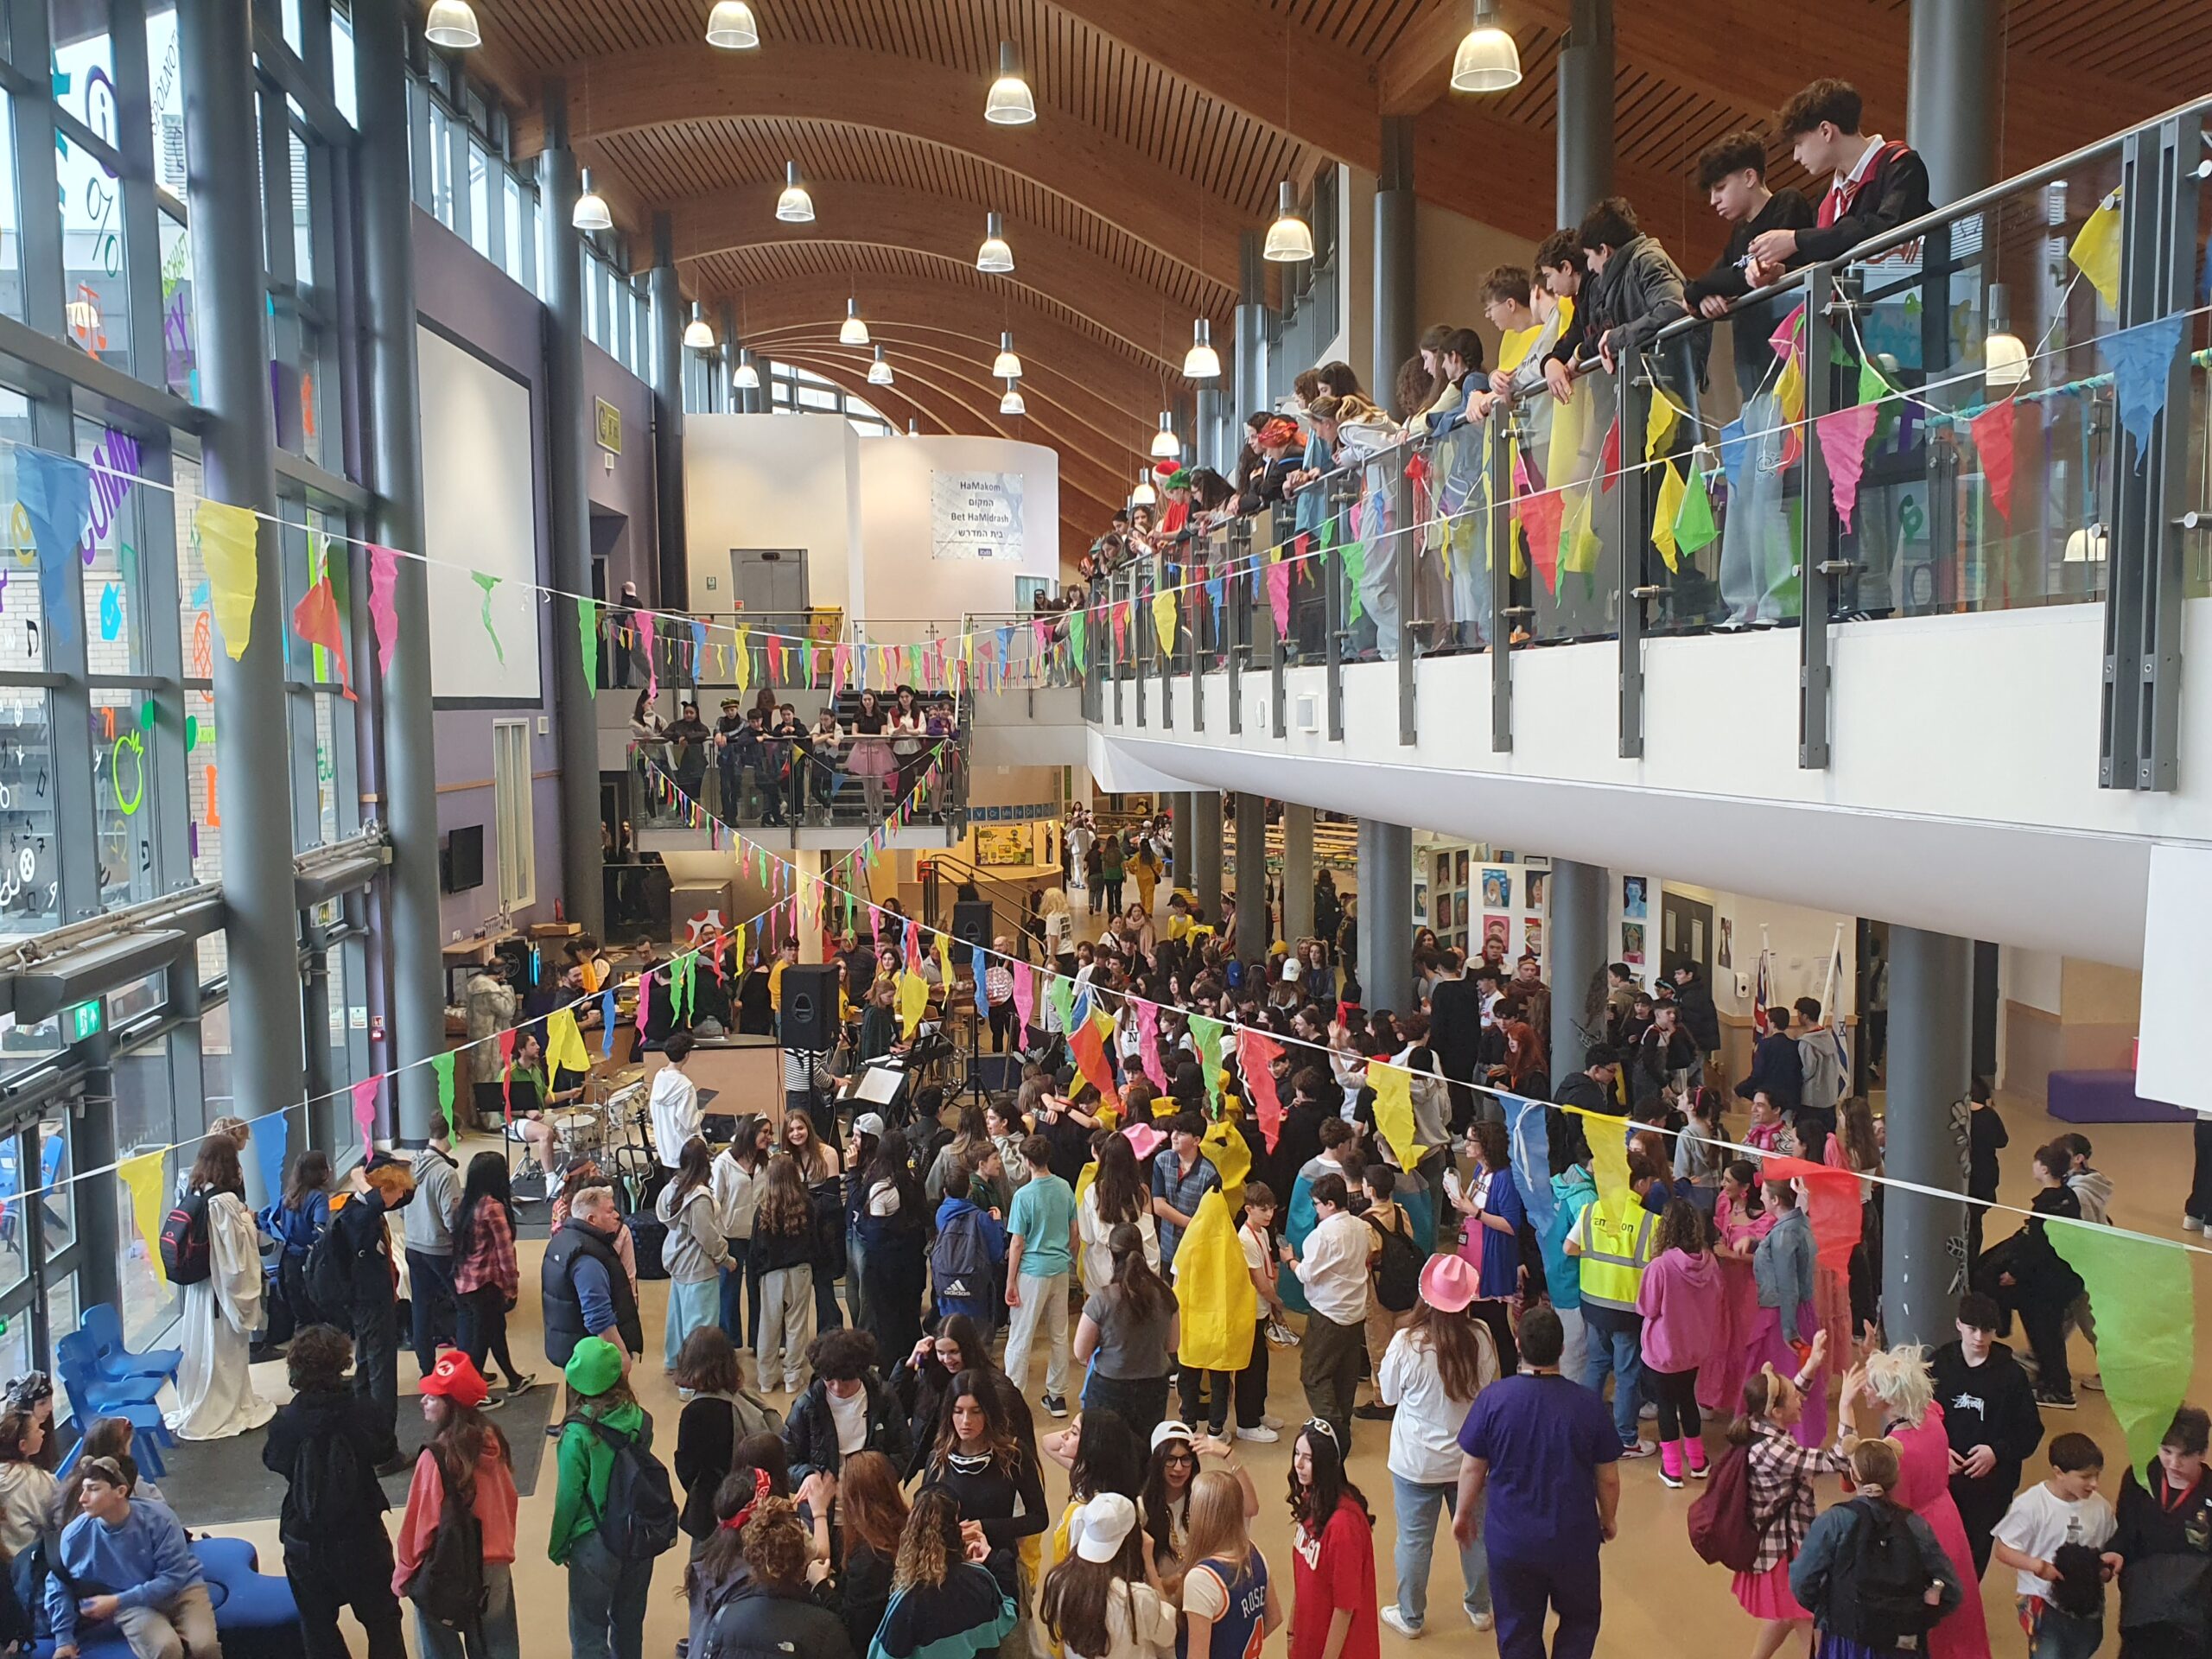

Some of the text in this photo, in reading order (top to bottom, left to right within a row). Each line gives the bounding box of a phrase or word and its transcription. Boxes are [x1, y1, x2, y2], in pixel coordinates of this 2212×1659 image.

[960, 481, 1001, 491] HaMakom
[969, 499, 994, 508] המקום
[951, 512, 1009, 523] Bet HaMidrash
[958, 529, 1004, 538] בית המדרש
[439, 1363, 451, 1375] M
[1241, 1586, 1265, 1618] ROSE
